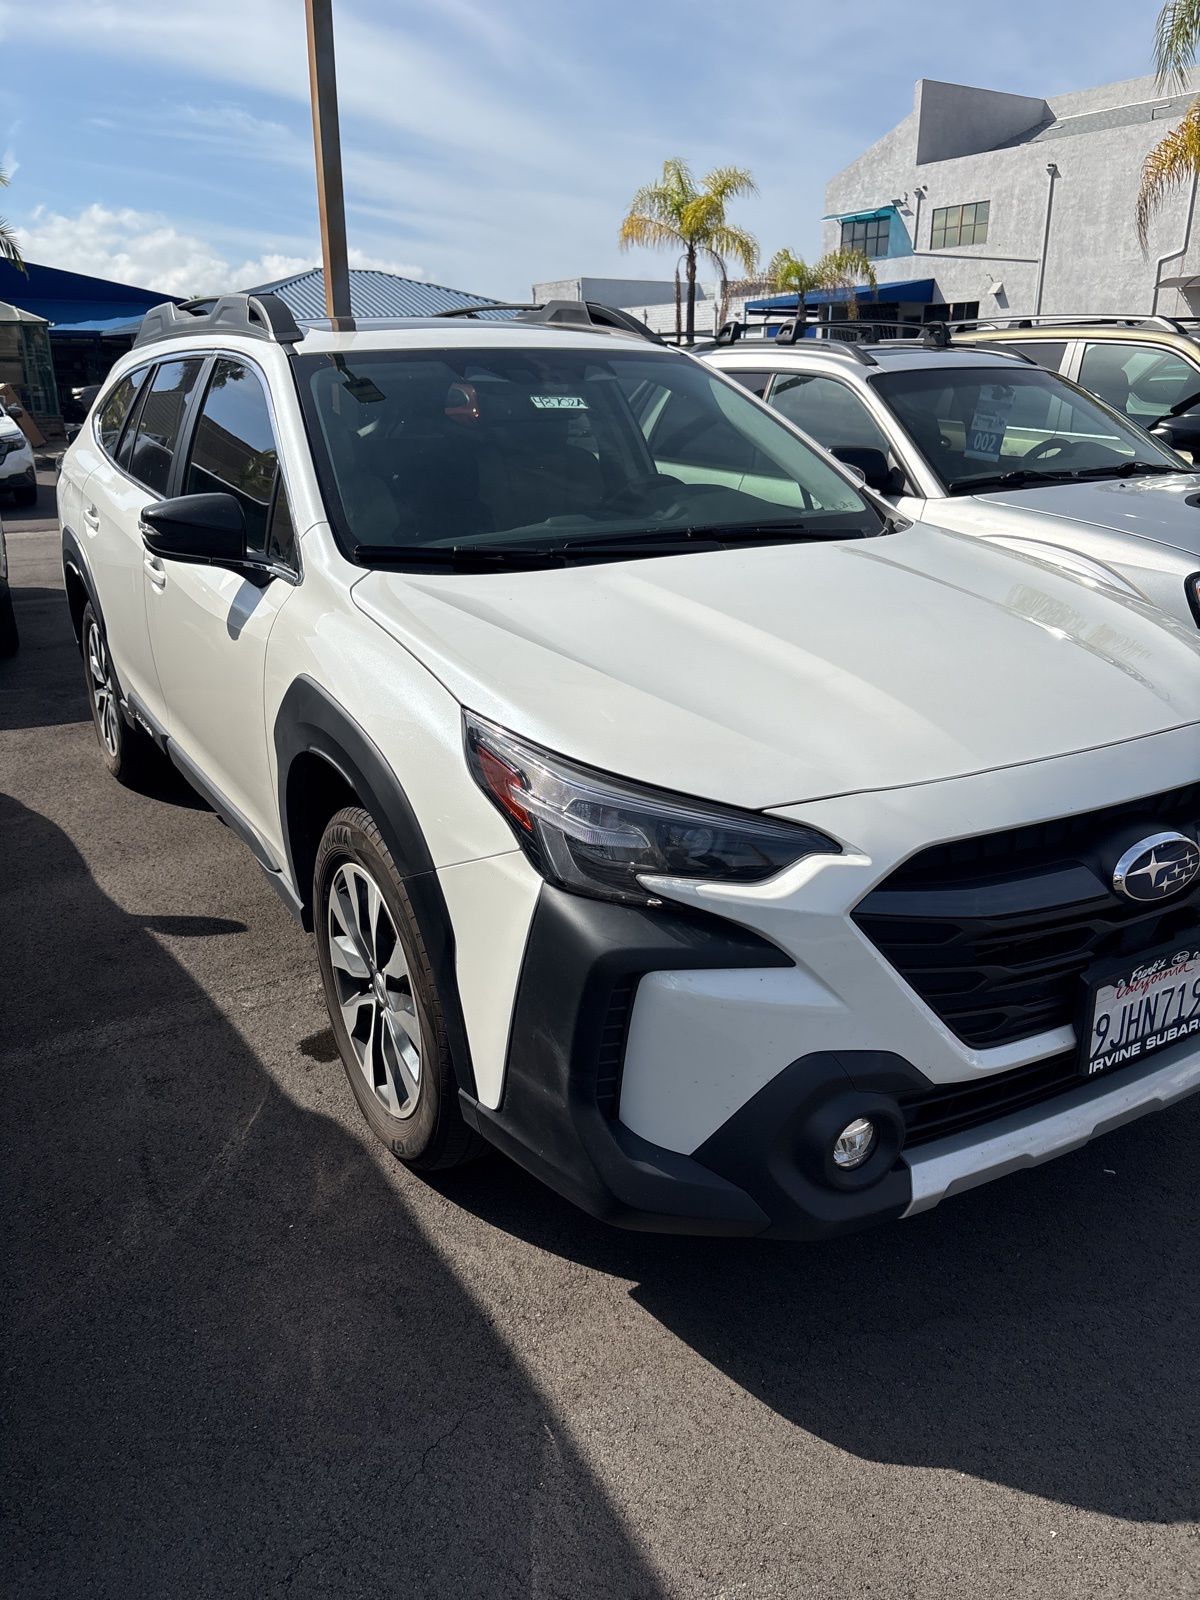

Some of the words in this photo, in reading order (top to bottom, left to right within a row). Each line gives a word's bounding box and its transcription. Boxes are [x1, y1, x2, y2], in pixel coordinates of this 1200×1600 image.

[973, 432, 997, 452] 002
[1116, 963, 1194, 1000] California
[1090, 977, 1200, 1059] 9JHN719
[1088, 1042, 1141, 1074] IRVINE
[1145, 1018, 1200, 1050] SUBAR
